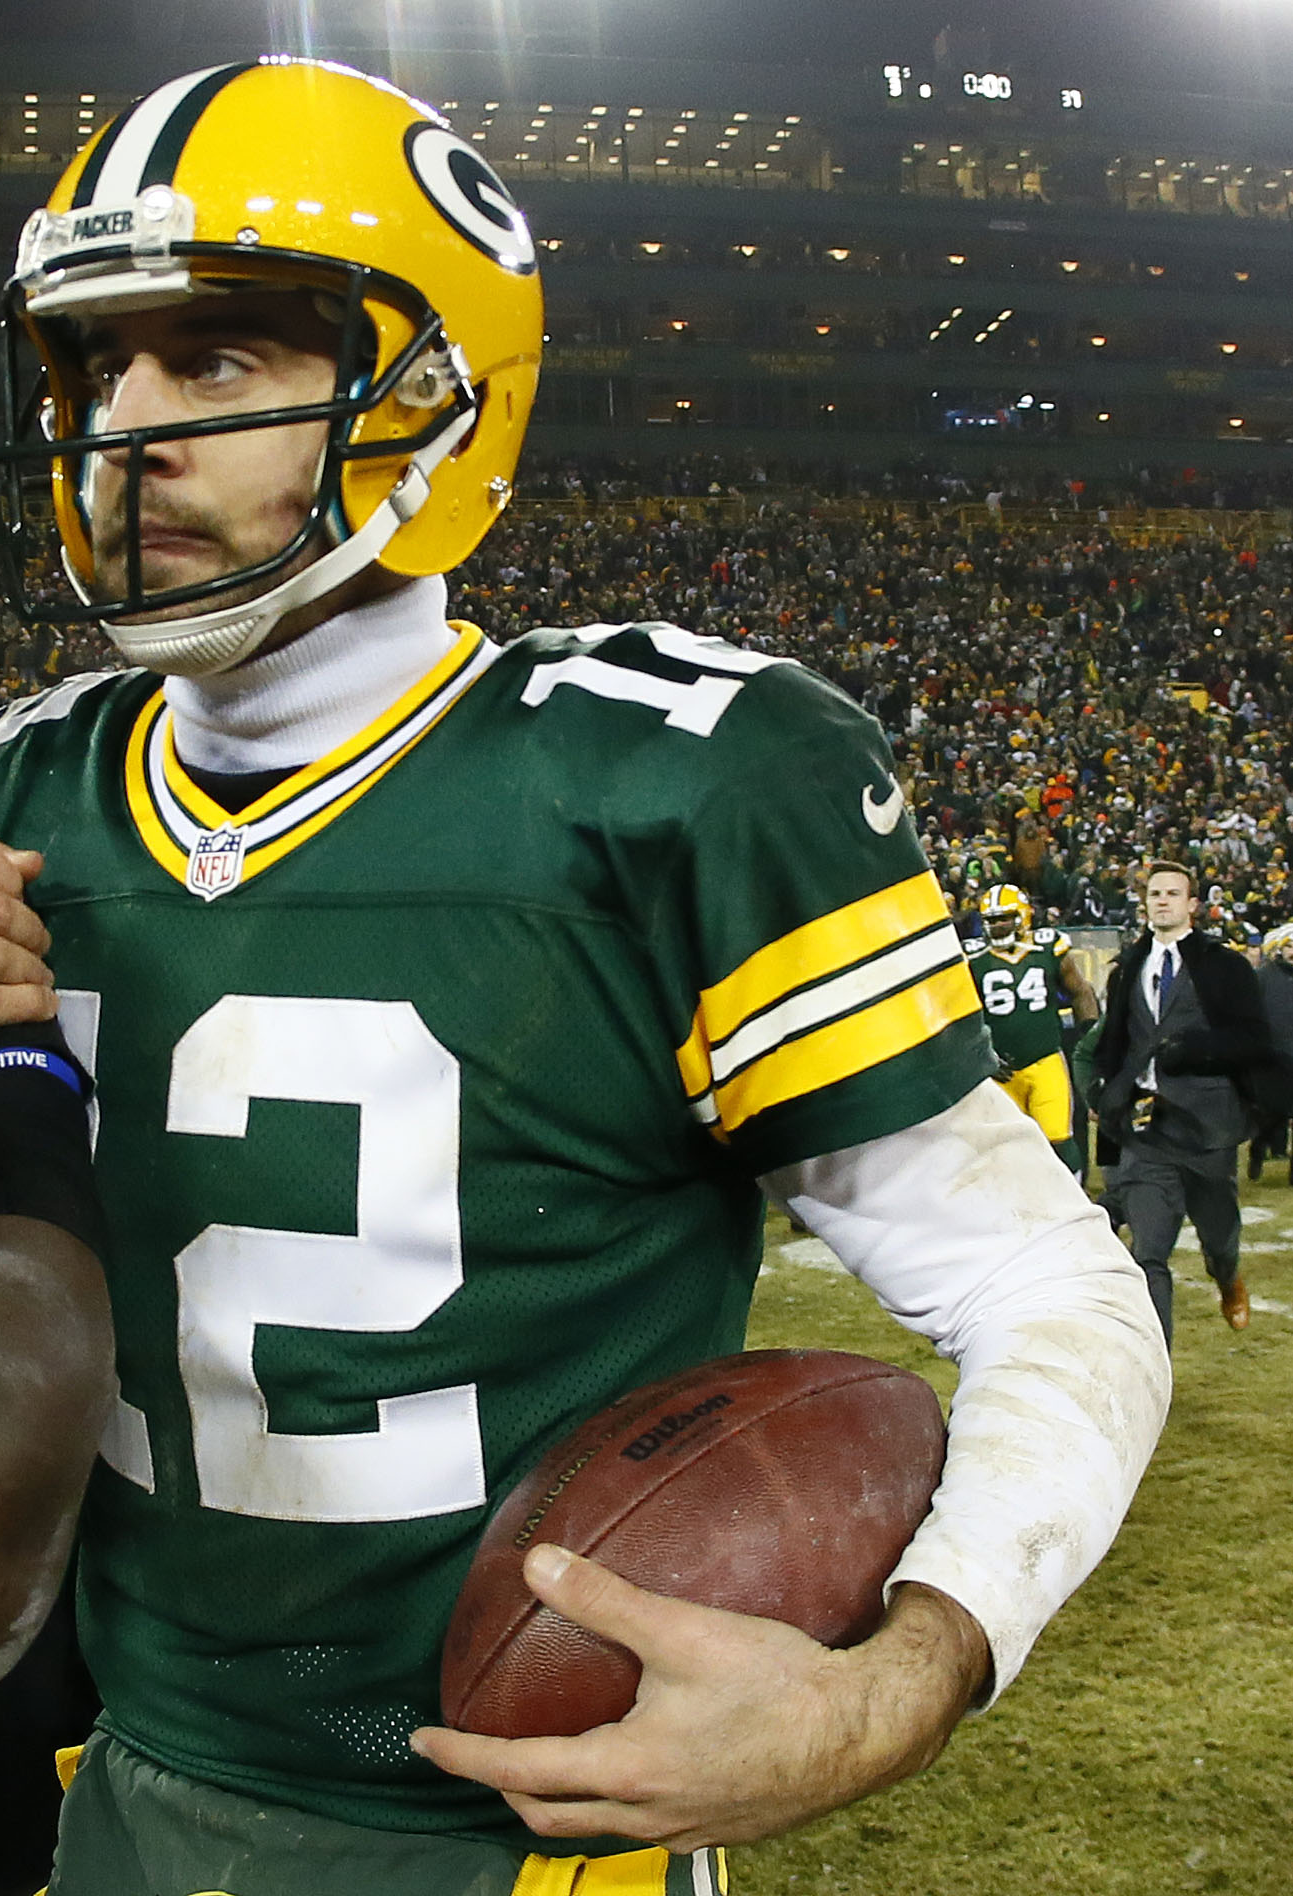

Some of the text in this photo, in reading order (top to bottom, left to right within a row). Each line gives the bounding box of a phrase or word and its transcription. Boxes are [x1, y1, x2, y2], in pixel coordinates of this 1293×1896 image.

[963, 73, 1012, 99] 0:00
[195, 855, 231, 887] NFL
[982, 966, 1048, 1016] 64
